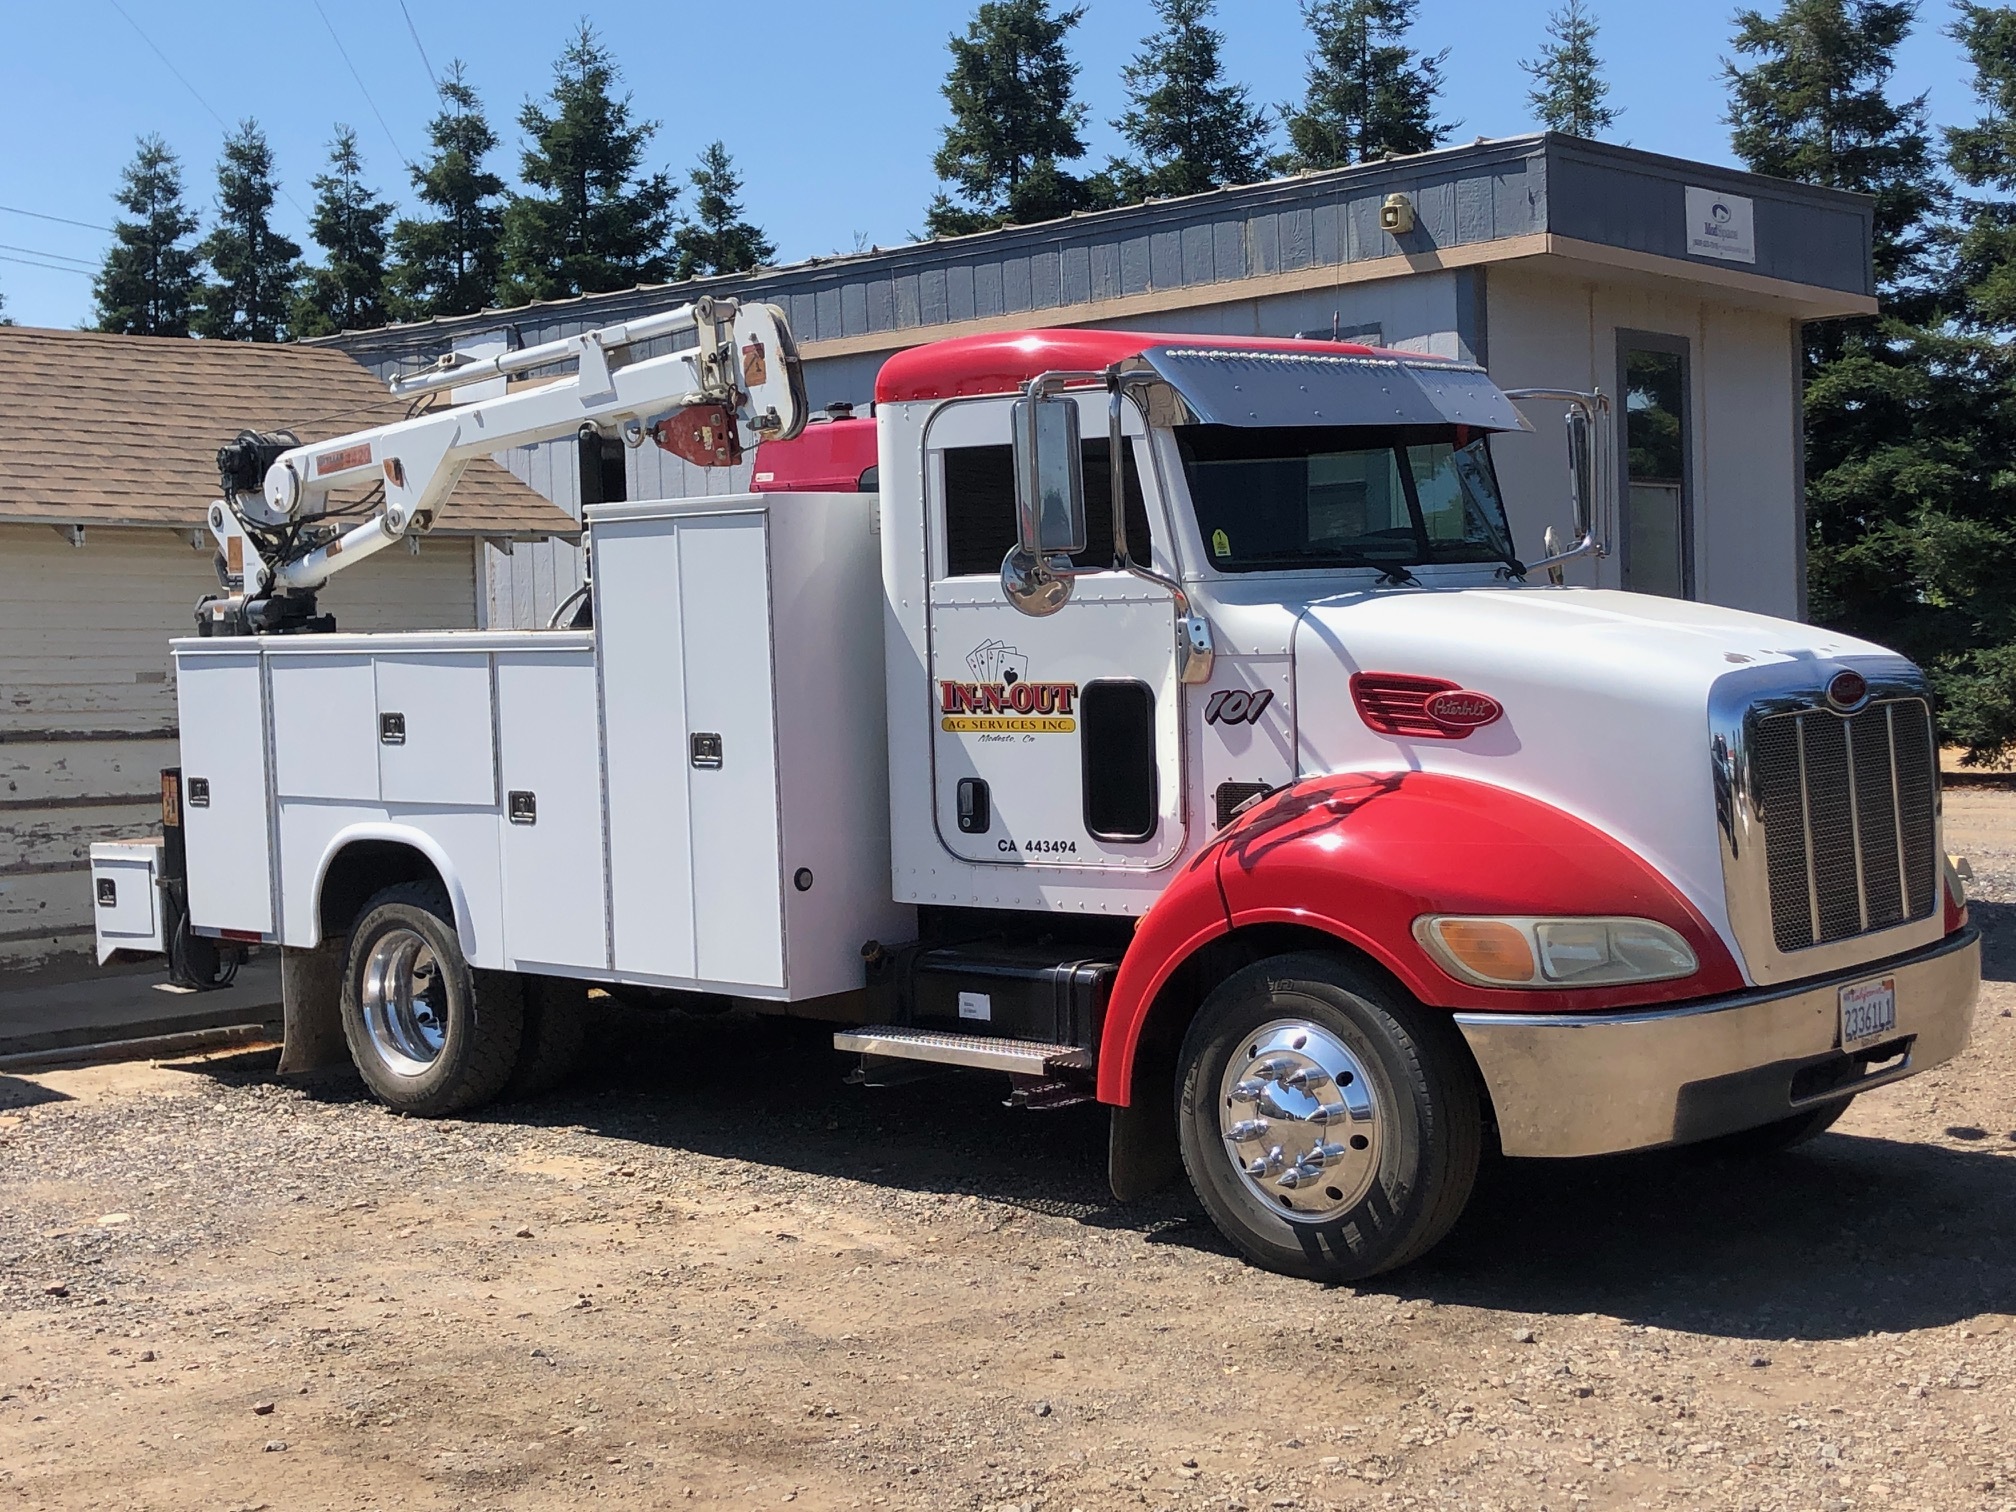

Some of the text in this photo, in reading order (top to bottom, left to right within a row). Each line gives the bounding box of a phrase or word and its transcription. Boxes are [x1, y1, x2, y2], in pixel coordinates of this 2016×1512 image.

[941, 680, 1078, 715] IN-N-OUT
[1205, 689, 1274, 725] 101
[1434, 697, 1490, 716] Peterbilt
[948, 720, 1071, 730] AG SERVICES INC.
[997, 839, 1077, 853] CA 443494
